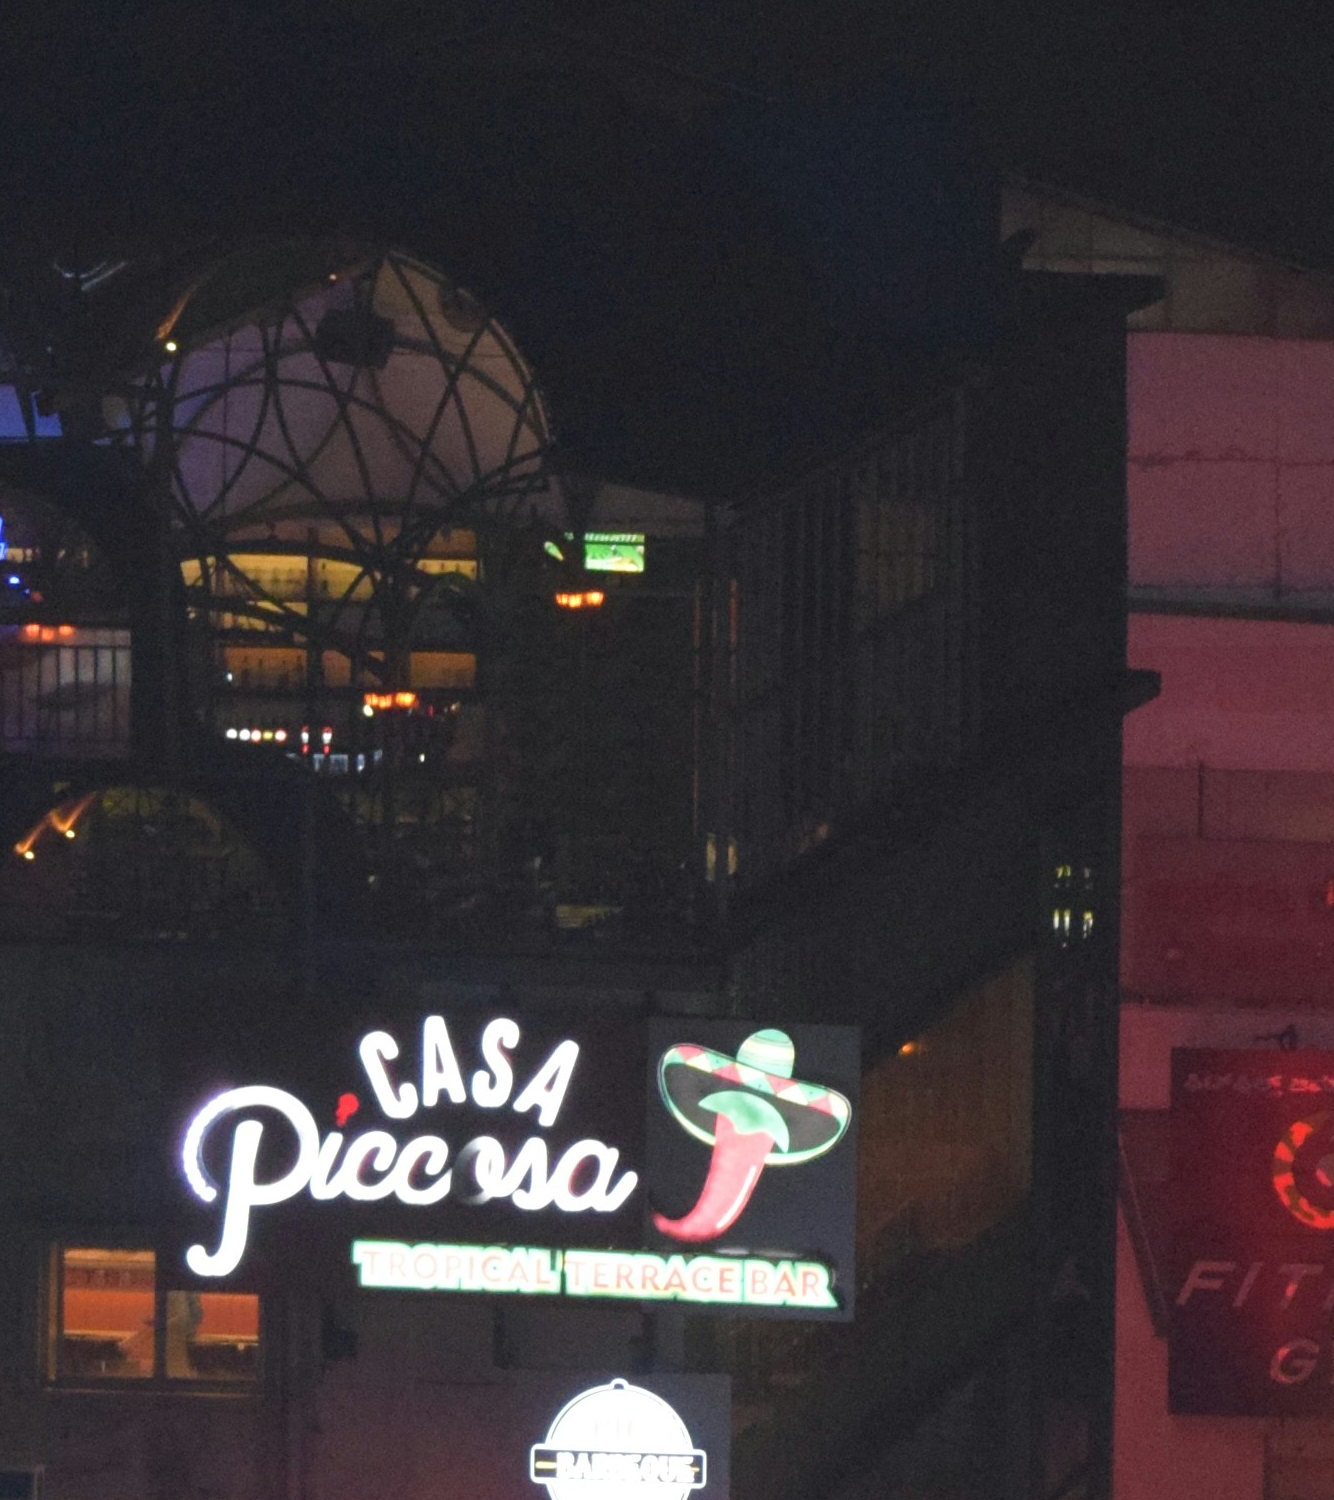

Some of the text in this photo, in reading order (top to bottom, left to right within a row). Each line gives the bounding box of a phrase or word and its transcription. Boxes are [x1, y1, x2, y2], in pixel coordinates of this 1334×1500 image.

[358, 1014, 580, 1129] CASA
[362, 1246, 824, 1300] TROPICAL TERRACE BAR
